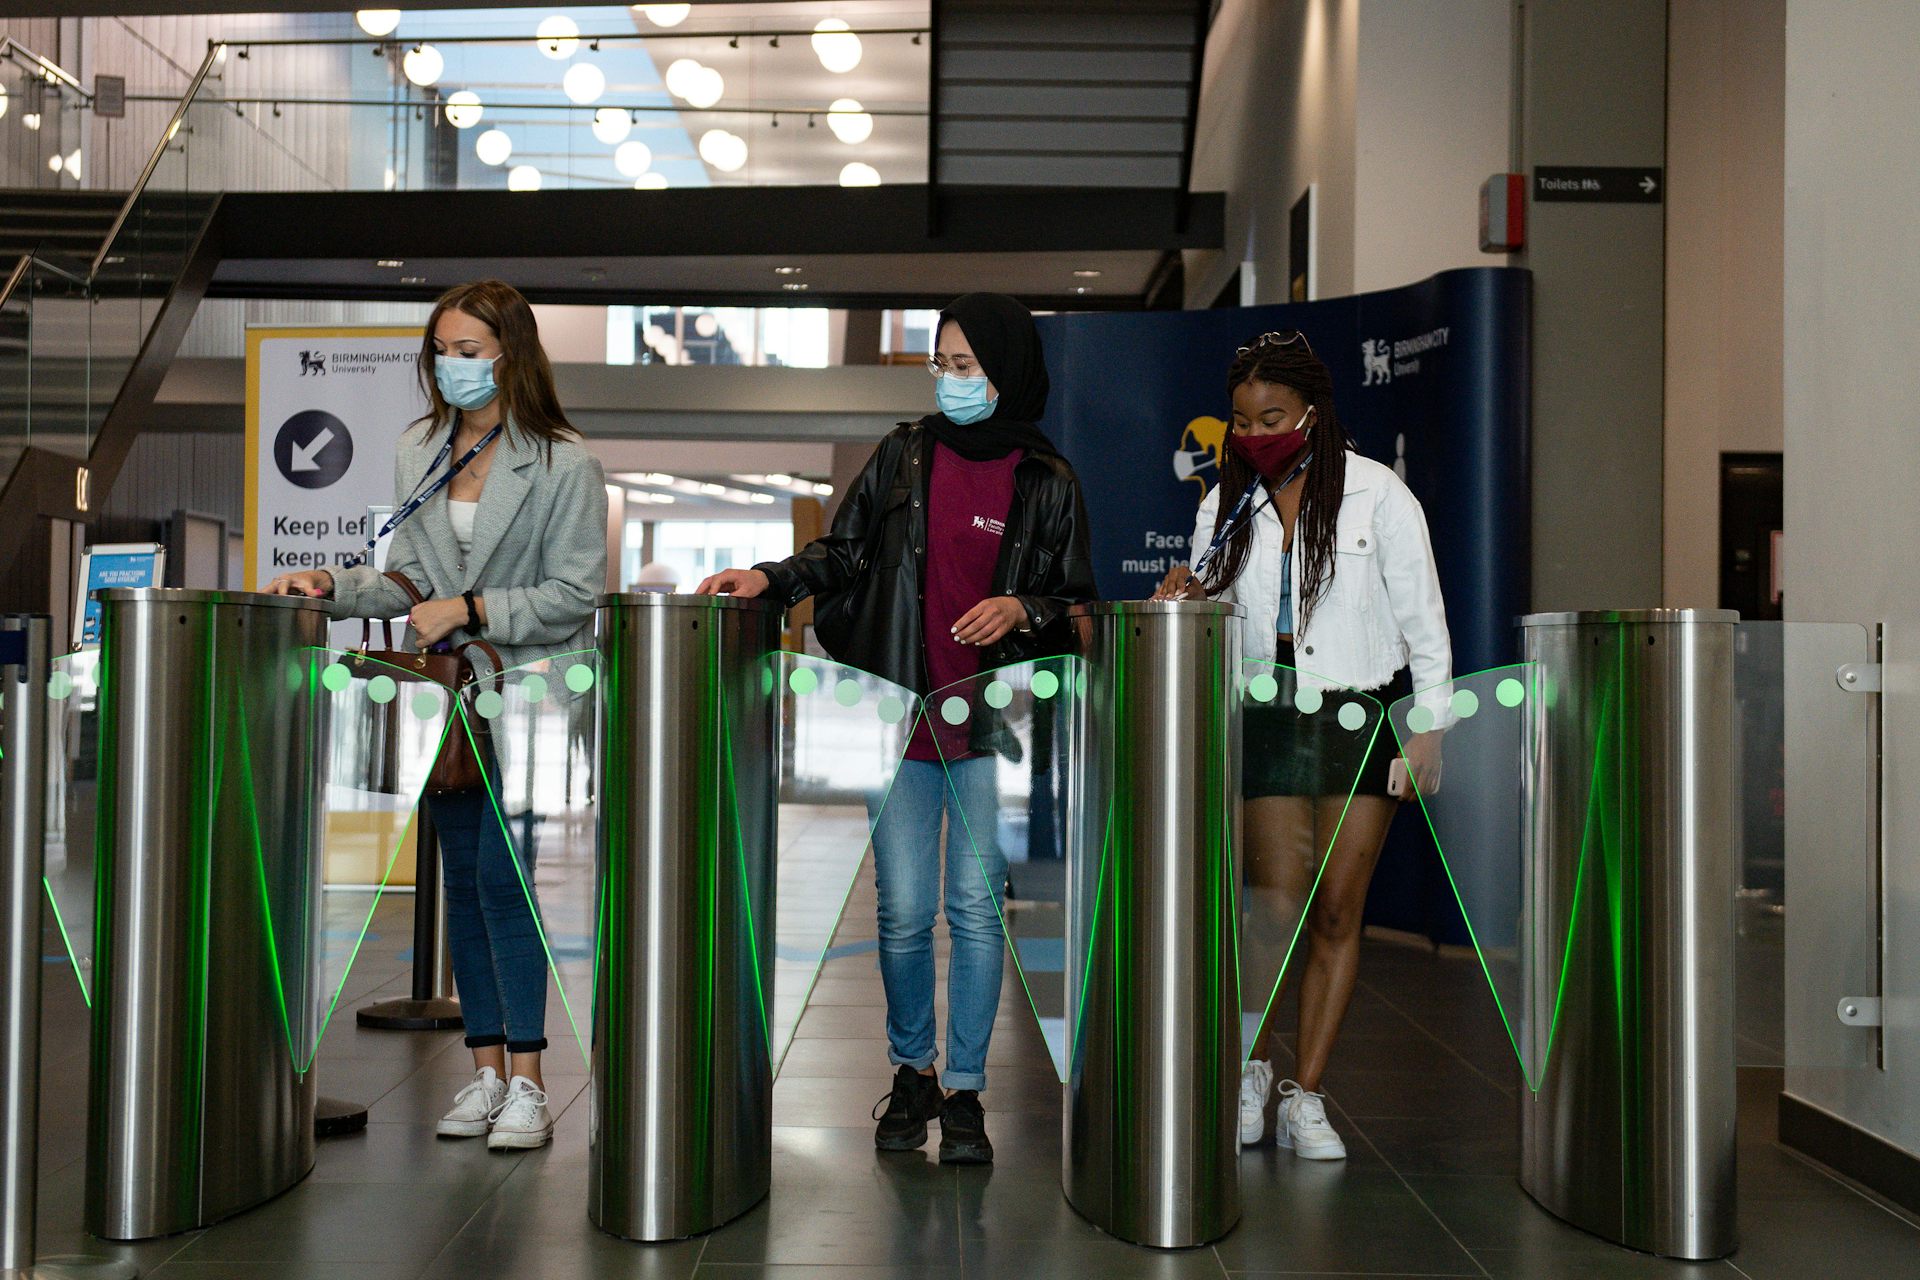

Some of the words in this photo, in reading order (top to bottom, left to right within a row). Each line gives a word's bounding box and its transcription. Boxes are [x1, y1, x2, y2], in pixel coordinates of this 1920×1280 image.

[1539, 178, 1579, 190] Toilets
[332, 353, 400, 363] BIRMINGHAM
[332, 365, 376, 375] University
[274, 516, 329, 540] Keep
[1145, 531, 1185, 548] Face
[273, 547, 327, 569] keep
[1122, 556, 1165, 573] must
